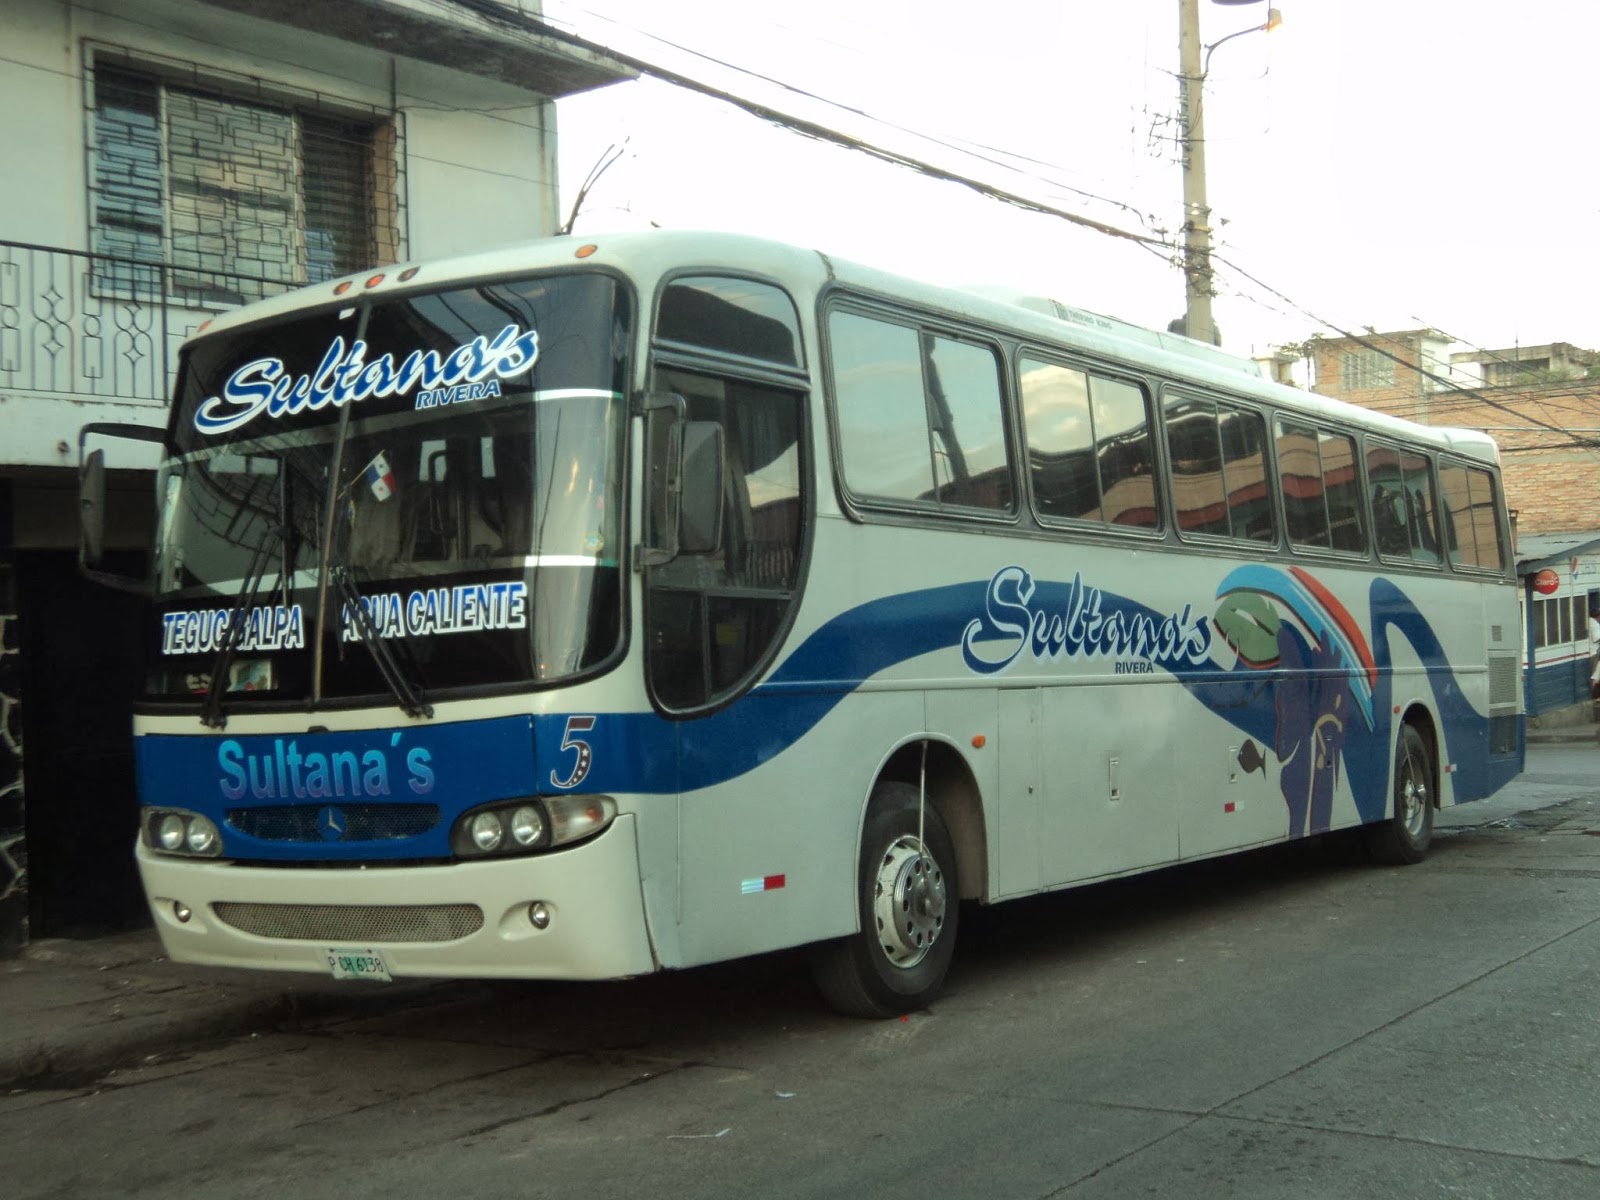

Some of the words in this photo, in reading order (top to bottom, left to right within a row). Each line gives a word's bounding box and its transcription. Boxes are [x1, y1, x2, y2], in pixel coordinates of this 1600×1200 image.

[415, 379, 501, 411] RIVERA
[406, 581, 527, 636] CALIENTE
[961, 564, 1212, 675] Sultana's
[1115, 661, 1154, 674] RIVERA
[550, 715, 596, 789] 5
